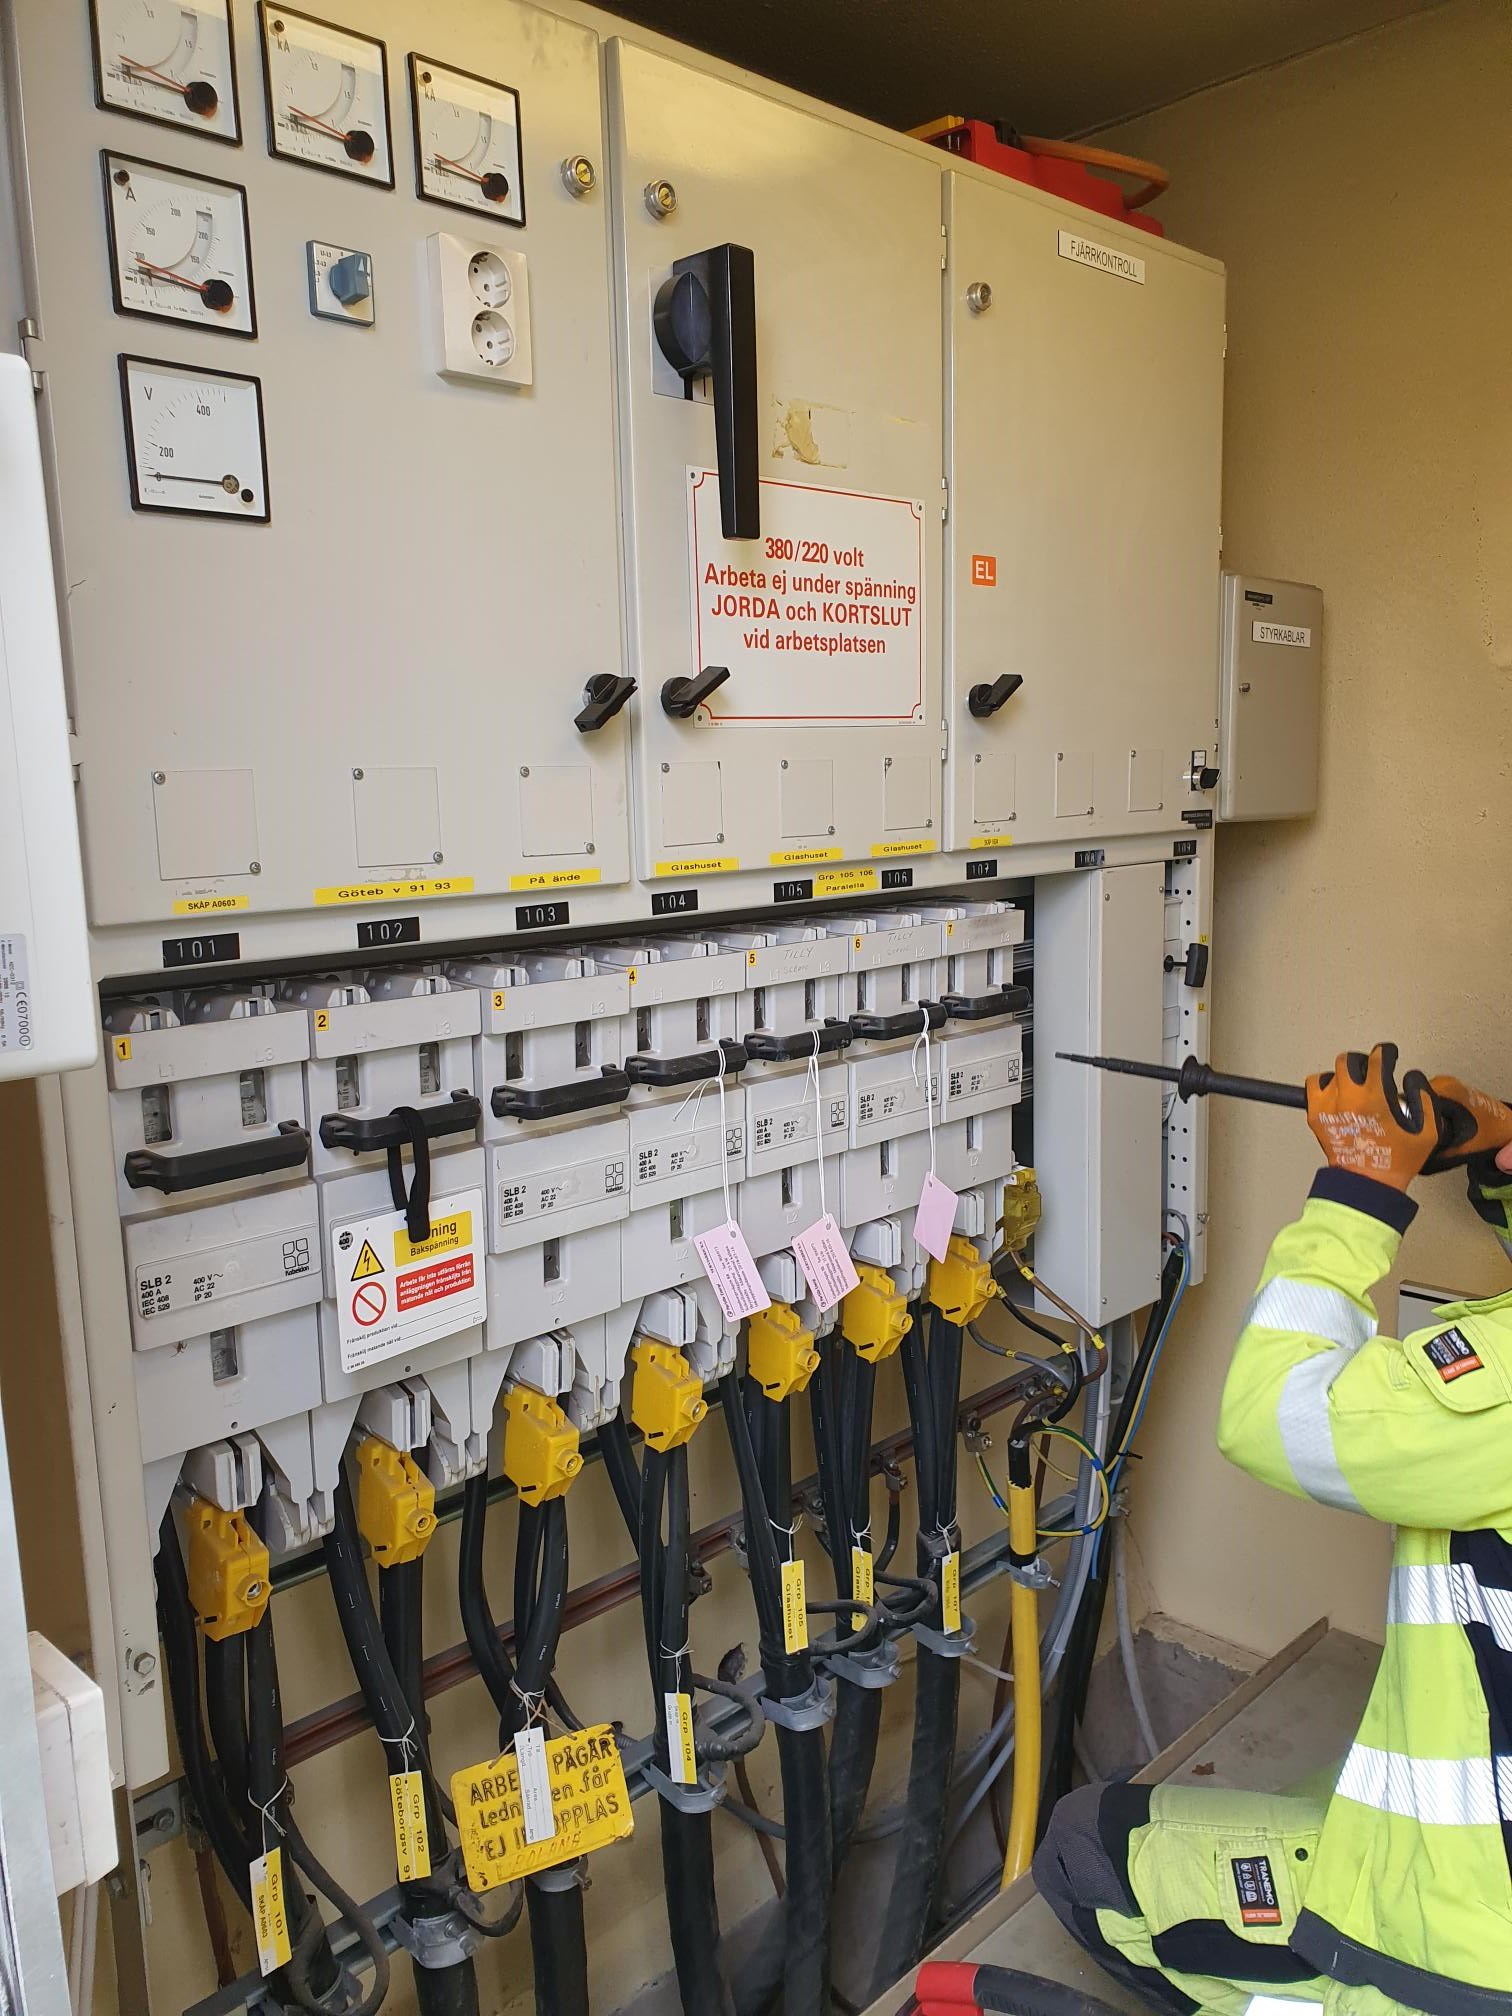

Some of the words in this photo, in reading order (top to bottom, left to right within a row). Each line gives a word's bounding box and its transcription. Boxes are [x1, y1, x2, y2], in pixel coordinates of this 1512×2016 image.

[277, 38, 291, 53] kA
[126, 186, 136, 202] A
[171, 207, 182, 217] 200
[146, 226, 156, 236] 150
[198, 230, 208, 240] 200
[190, 254, 200, 264] 150
[1071, 240, 1137, 277] FJÄRRKONTROLL
[144, 386, 152, 400] V
[196, 405, 210, 416] 400
[159, 446, 174, 458] 200
[765, 537, 828, 563] 380/220
[833, 547, 864, 567] volt
[976, 560, 994, 580] EL
[705, 563, 766, 589] Arbeta
[772, 570, 787, 595] ej
[793, 574, 840, 595] under
[846, 577, 915, 603] spänning
[712, 595, 780, 619] JORDA
[786, 602, 817, 622] och
[823, 603, 912, 626] KORTSLUT
[1260, 627, 1304, 643] STYRKABLAR
[744, 629, 769, 649] vid
[776, 630, 885, 656] arbetsplatsen
[883, 844, 922, 852] Glashuset
[784, 851, 828, 860] Glashuset
[671, 861, 722, 872] Glashuset
[529, 875, 546, 884] På
[552, 873, 581, 882] ände
[818, 872, 835, 882] Grp
[888, 871, 907, 885] 106
[338, 887, 384, 899] Göteb
[410, 884, 425, 892] 91
[434, 882, 452, 890] 93
[780, 883, 803, 898] 105
[188, 901, 210, 910] SKÅP
[212, 900, 236, 908] A0603
[660, 893, 686, 909] 104
[524, 906, 556, 924] 103
[366, 922, 404, 941] 102
[948, 924, 952, 934] 7
[176, 938, 216, 959] 101
[856, 938, 860, 948] 6
[750, 954, 755, 964] 5
[629, 971, 636, 982] 4
[495, 996, 502, 1006] 3
[318, 1014, 326, 1028] 2
[119, 1042, 126, 1056] 1
[860, 1094, 870, 1103] SLB
[757, 1119, 768, 1128] SLB
[639, 1150, 652, 1160] SLB
[654, 1149, 658, 1157] 2
[504, 1187, 519, 1197] SLB
[432, 1222, 456, 1237] ning
[411, 1237, 458, 1256] Bakspänning
[140, 1277, 162, 1290] SLB
[165, 1275, 171, 1284] 2
[194, 1285, 204, 1293] AC
[207, 1282, 215, 1290] 22
[400, 1279, 417, 1288] Arbete
[434, 1285, 443, 1293] och
[445, 1277, 471, 1291] produktion
[142, 1290, 153, 1299] 400
[142, 1298, 154, 1308] IEC
[143, 1307, 155, 1315] IEC
[158, 1303, 170, 1311] 529
[470, 1770, 518, 1806] ARBE
[552, 1737, 613, 1775] PÅGÅR
[394, 1777, 408, 1856] Göteborgsv
[404, 1865, 411, 1880] 91
[412, 1794, 420, 1819] Grp
[416, 1830, 424, 1852] 102
[485, 1836, 506, 1861] EJ
[1259, 1860, 1274, 1905] TRANEMO
[274, 1912, 284, 1936] 101
